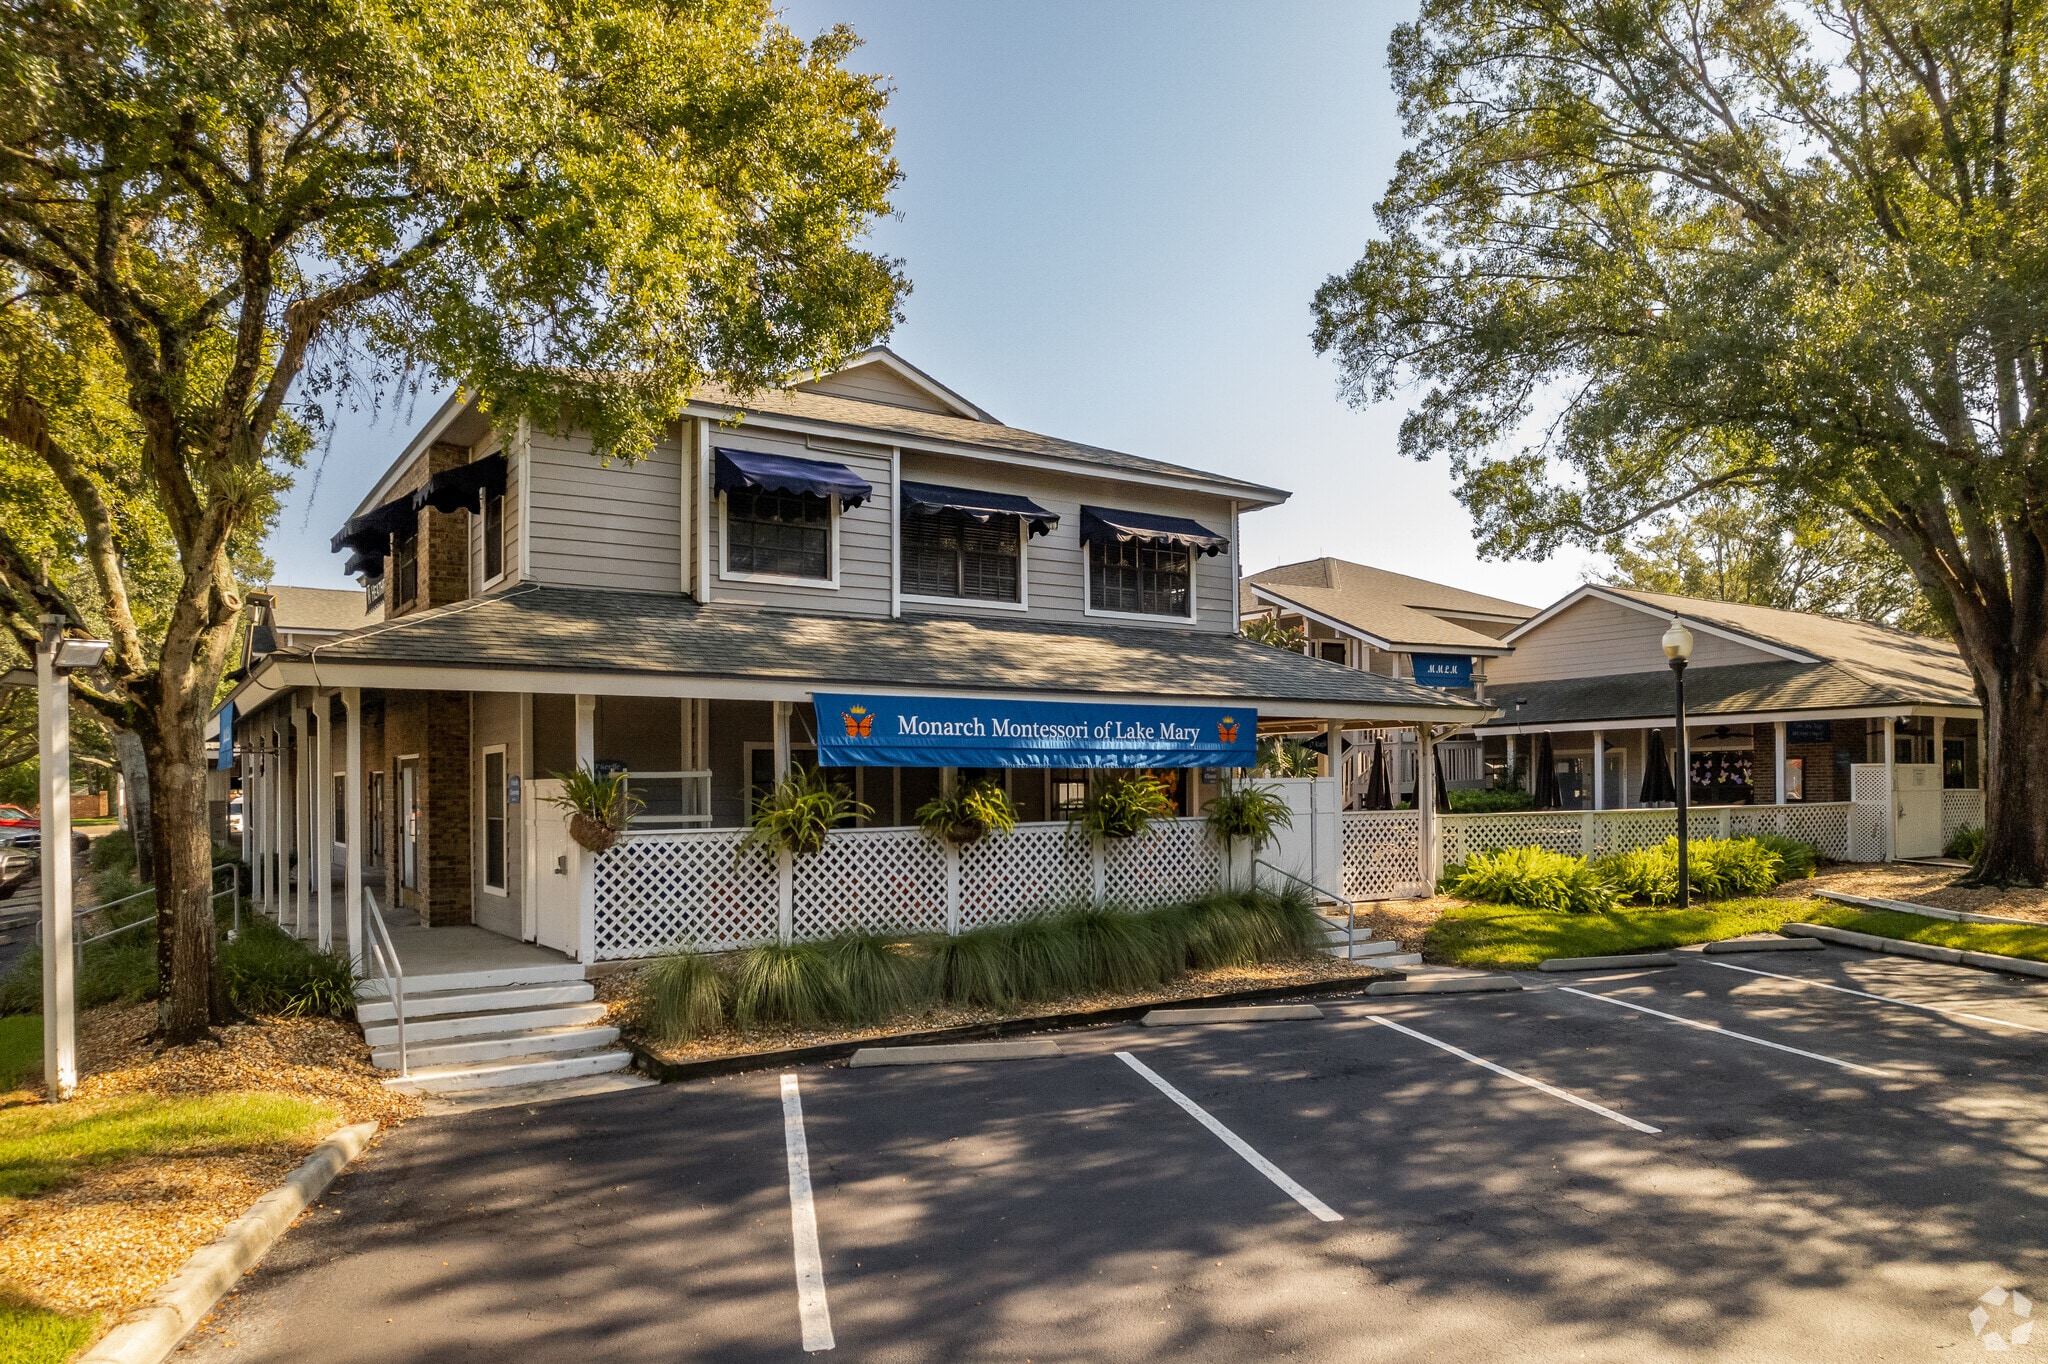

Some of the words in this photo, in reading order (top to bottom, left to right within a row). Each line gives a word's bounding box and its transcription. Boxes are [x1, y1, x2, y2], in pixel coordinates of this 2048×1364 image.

[897, 715, 986, 737] Monarch
[991, 718, 1089, 739] Montessori
[1094, 721, 1113, 739] of
[1115, 721, 1155, 740] Lake
[1160, 722, 1200, 747] Mary
